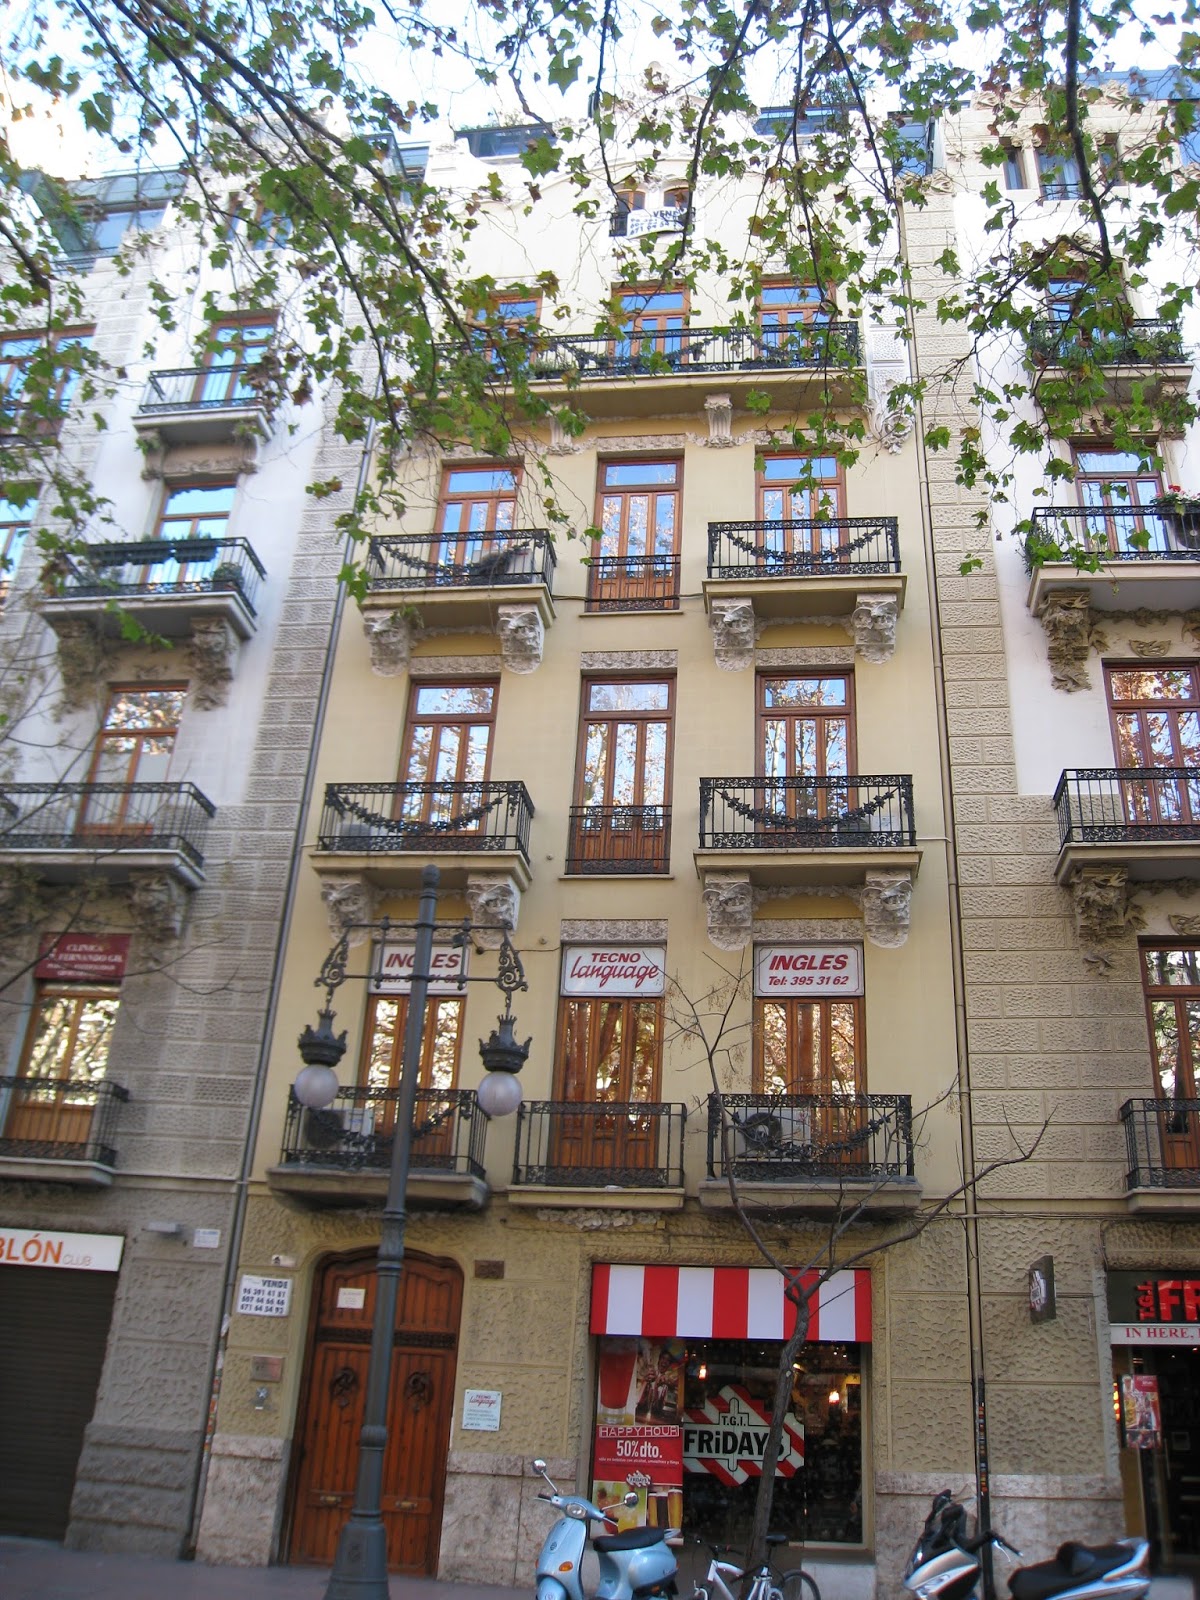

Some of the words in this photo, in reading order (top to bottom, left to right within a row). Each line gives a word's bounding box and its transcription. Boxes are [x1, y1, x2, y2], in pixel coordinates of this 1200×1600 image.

[385, 953, 461, 969] INES
[592, 953, 641, 963] TECNO
[768, 954, 849, 971] INGLES
[768, 976, 788, 986] Tel:
[790, 976, 814, 986] 395
[816, 976, 830, 986] 31
[832, 976, 849, 986] 62
[63, 1254, 92, 1266] CLUB
[262, 1280, 288, 1289] VENDE
[1125, 1327, 1142, 1339] IN
[1146, 1327, 1194, 1340] HERE,
[721, 1416, 746, 1426] T.G.I.
[600, 1426, 642, 1437] HAPPY
[644, 1426, 678, 1437] HOUR
